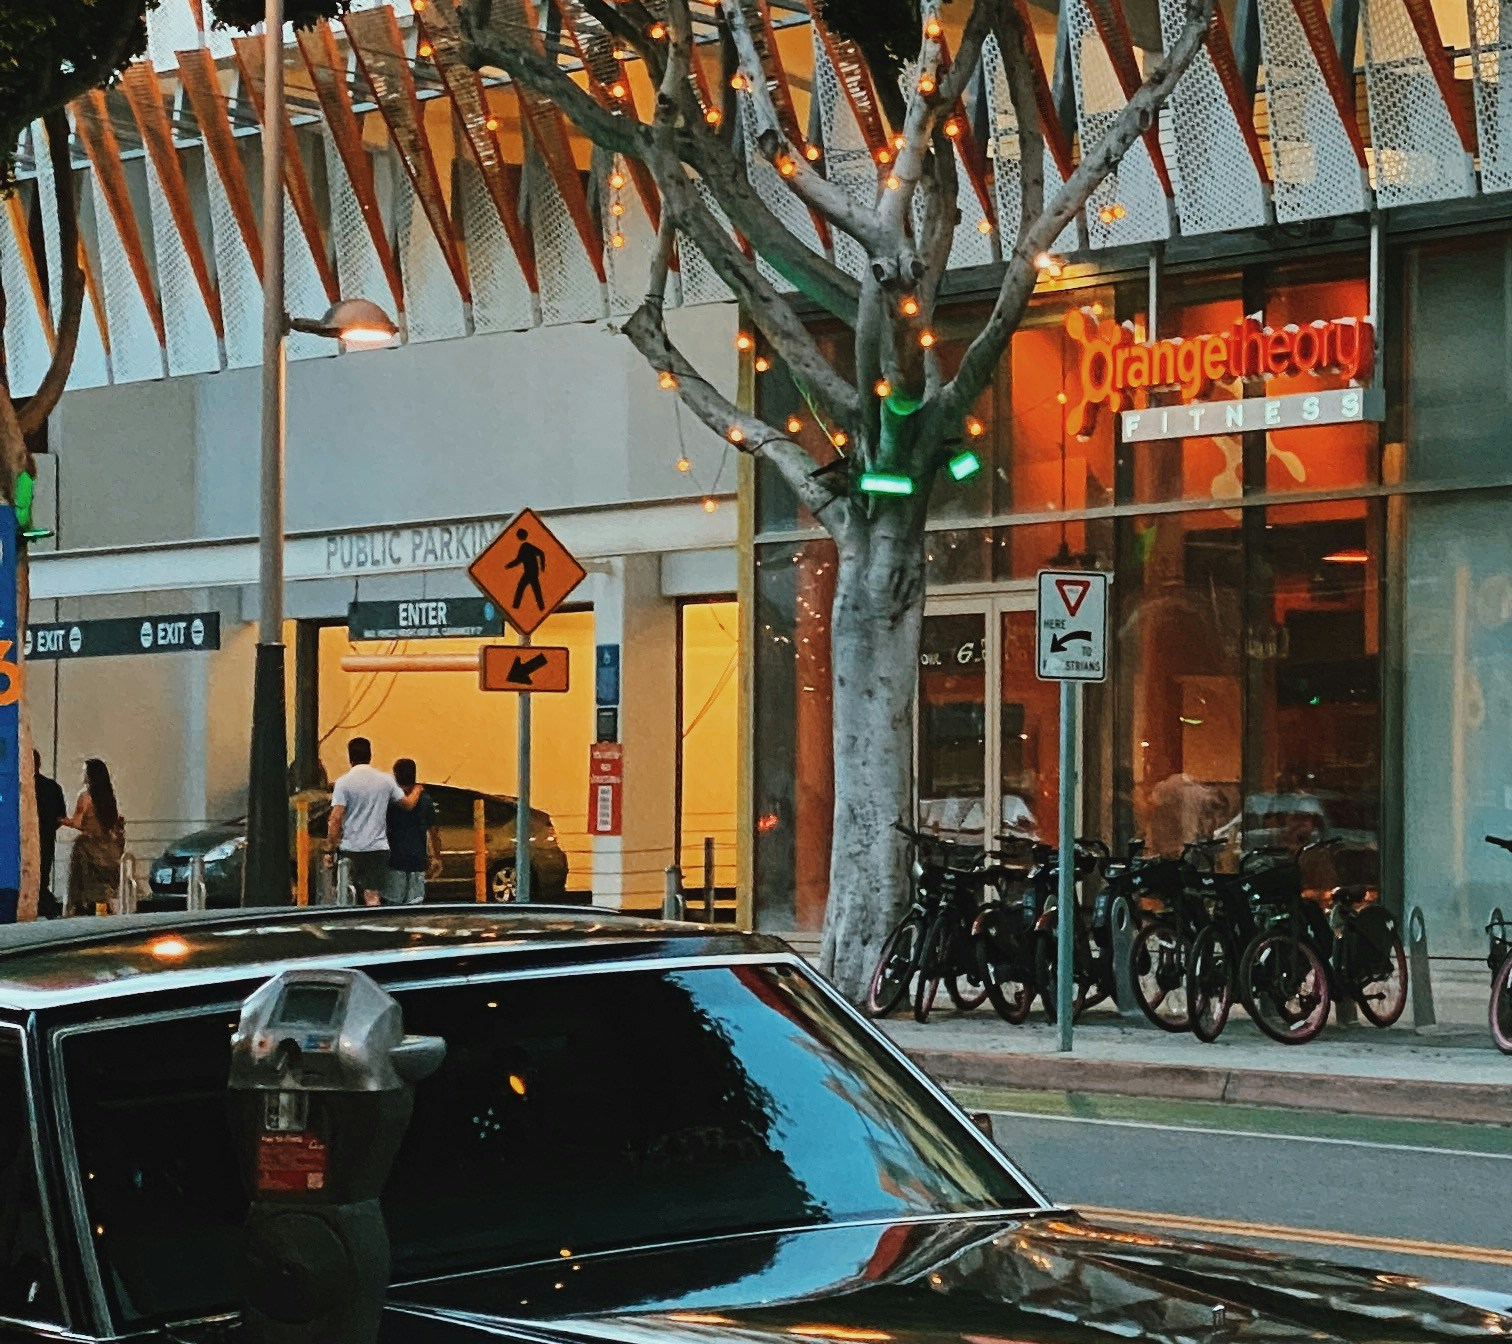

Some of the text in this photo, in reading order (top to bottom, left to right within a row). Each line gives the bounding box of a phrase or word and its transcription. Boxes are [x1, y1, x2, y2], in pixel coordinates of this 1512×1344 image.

[1125, 391, 1361, 438] FITNESS
[326, 520, 501, 571] PUBLIC PARKIN
[398, 600, 448, 627] ENTER
[1043, 619, 1067, 630] HERE
[37, 629, 66, 652] EXIT
[157, 621, 188, 645] EXIT
[1082, 646, 1093, 657] TO
